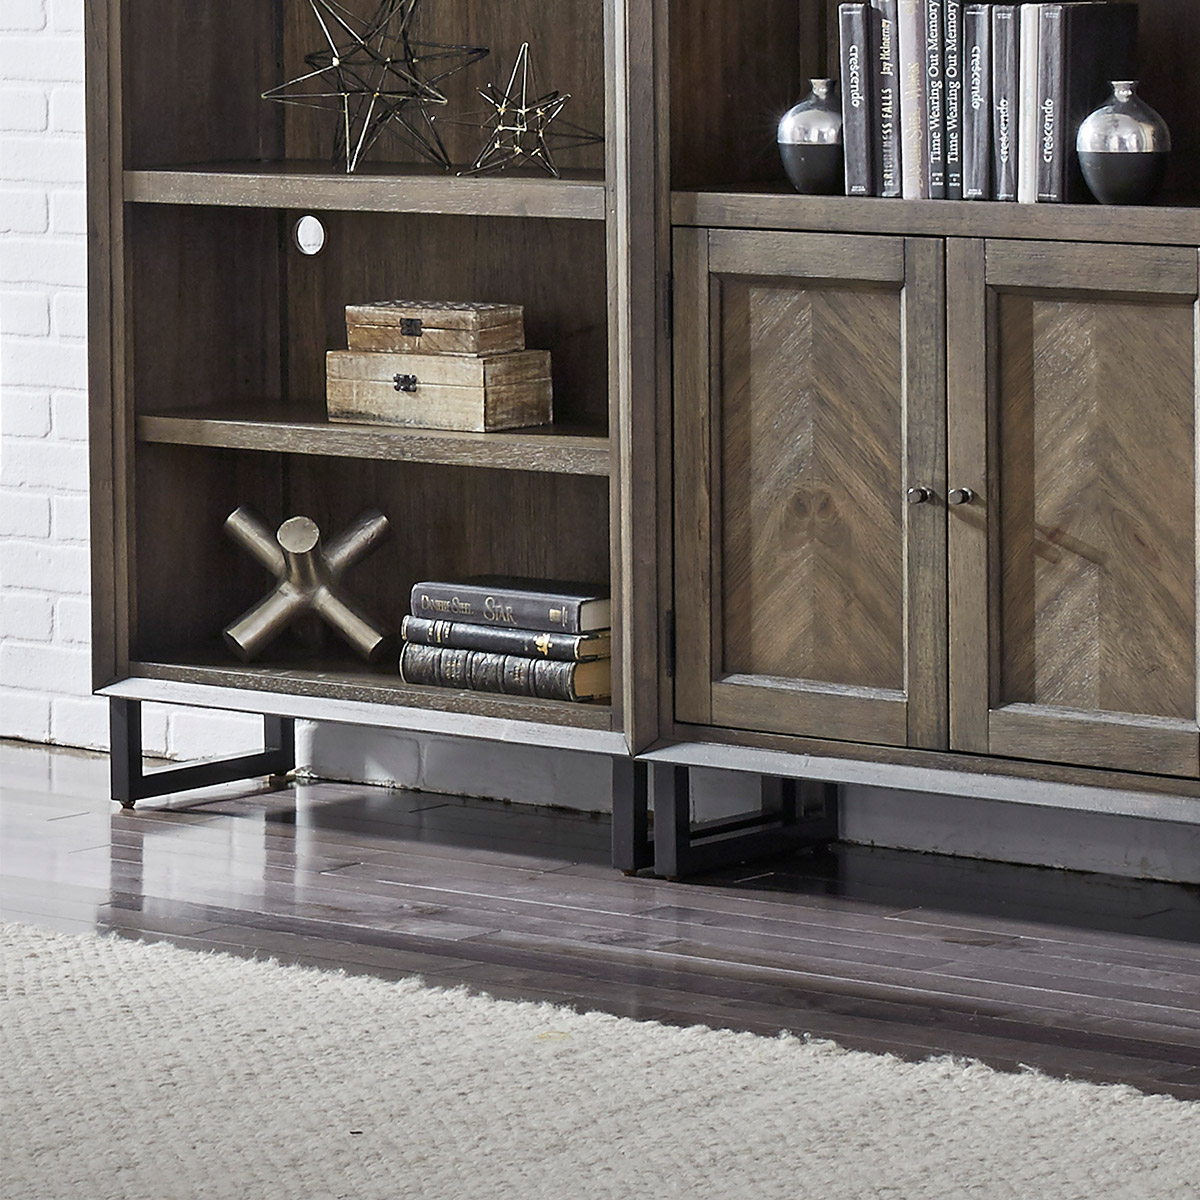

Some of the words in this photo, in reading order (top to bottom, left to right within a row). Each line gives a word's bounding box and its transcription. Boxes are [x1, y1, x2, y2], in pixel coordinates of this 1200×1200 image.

[927, 0, 941, 51] Memory
[945, 0, 959, 52] Memory
[849, 45, 864, 108] crescendo
[880, 61, 893, 77] Jay
[928, 54, 941, 77] Out
[945, 54, 958, 78] Out
[971, 45, 985, 109] crescendo
[881, 88, 892, 119] FALLS
[929, 80, 943, 129] Wearing
[946, 80, 960, 130] Wearing
[929, 132, 942, 163] Time
[946, 133, 959, 164] Time
[996, 98, 1009, 163] crescendo
[1041, 98, 1054, 163] crescendo
